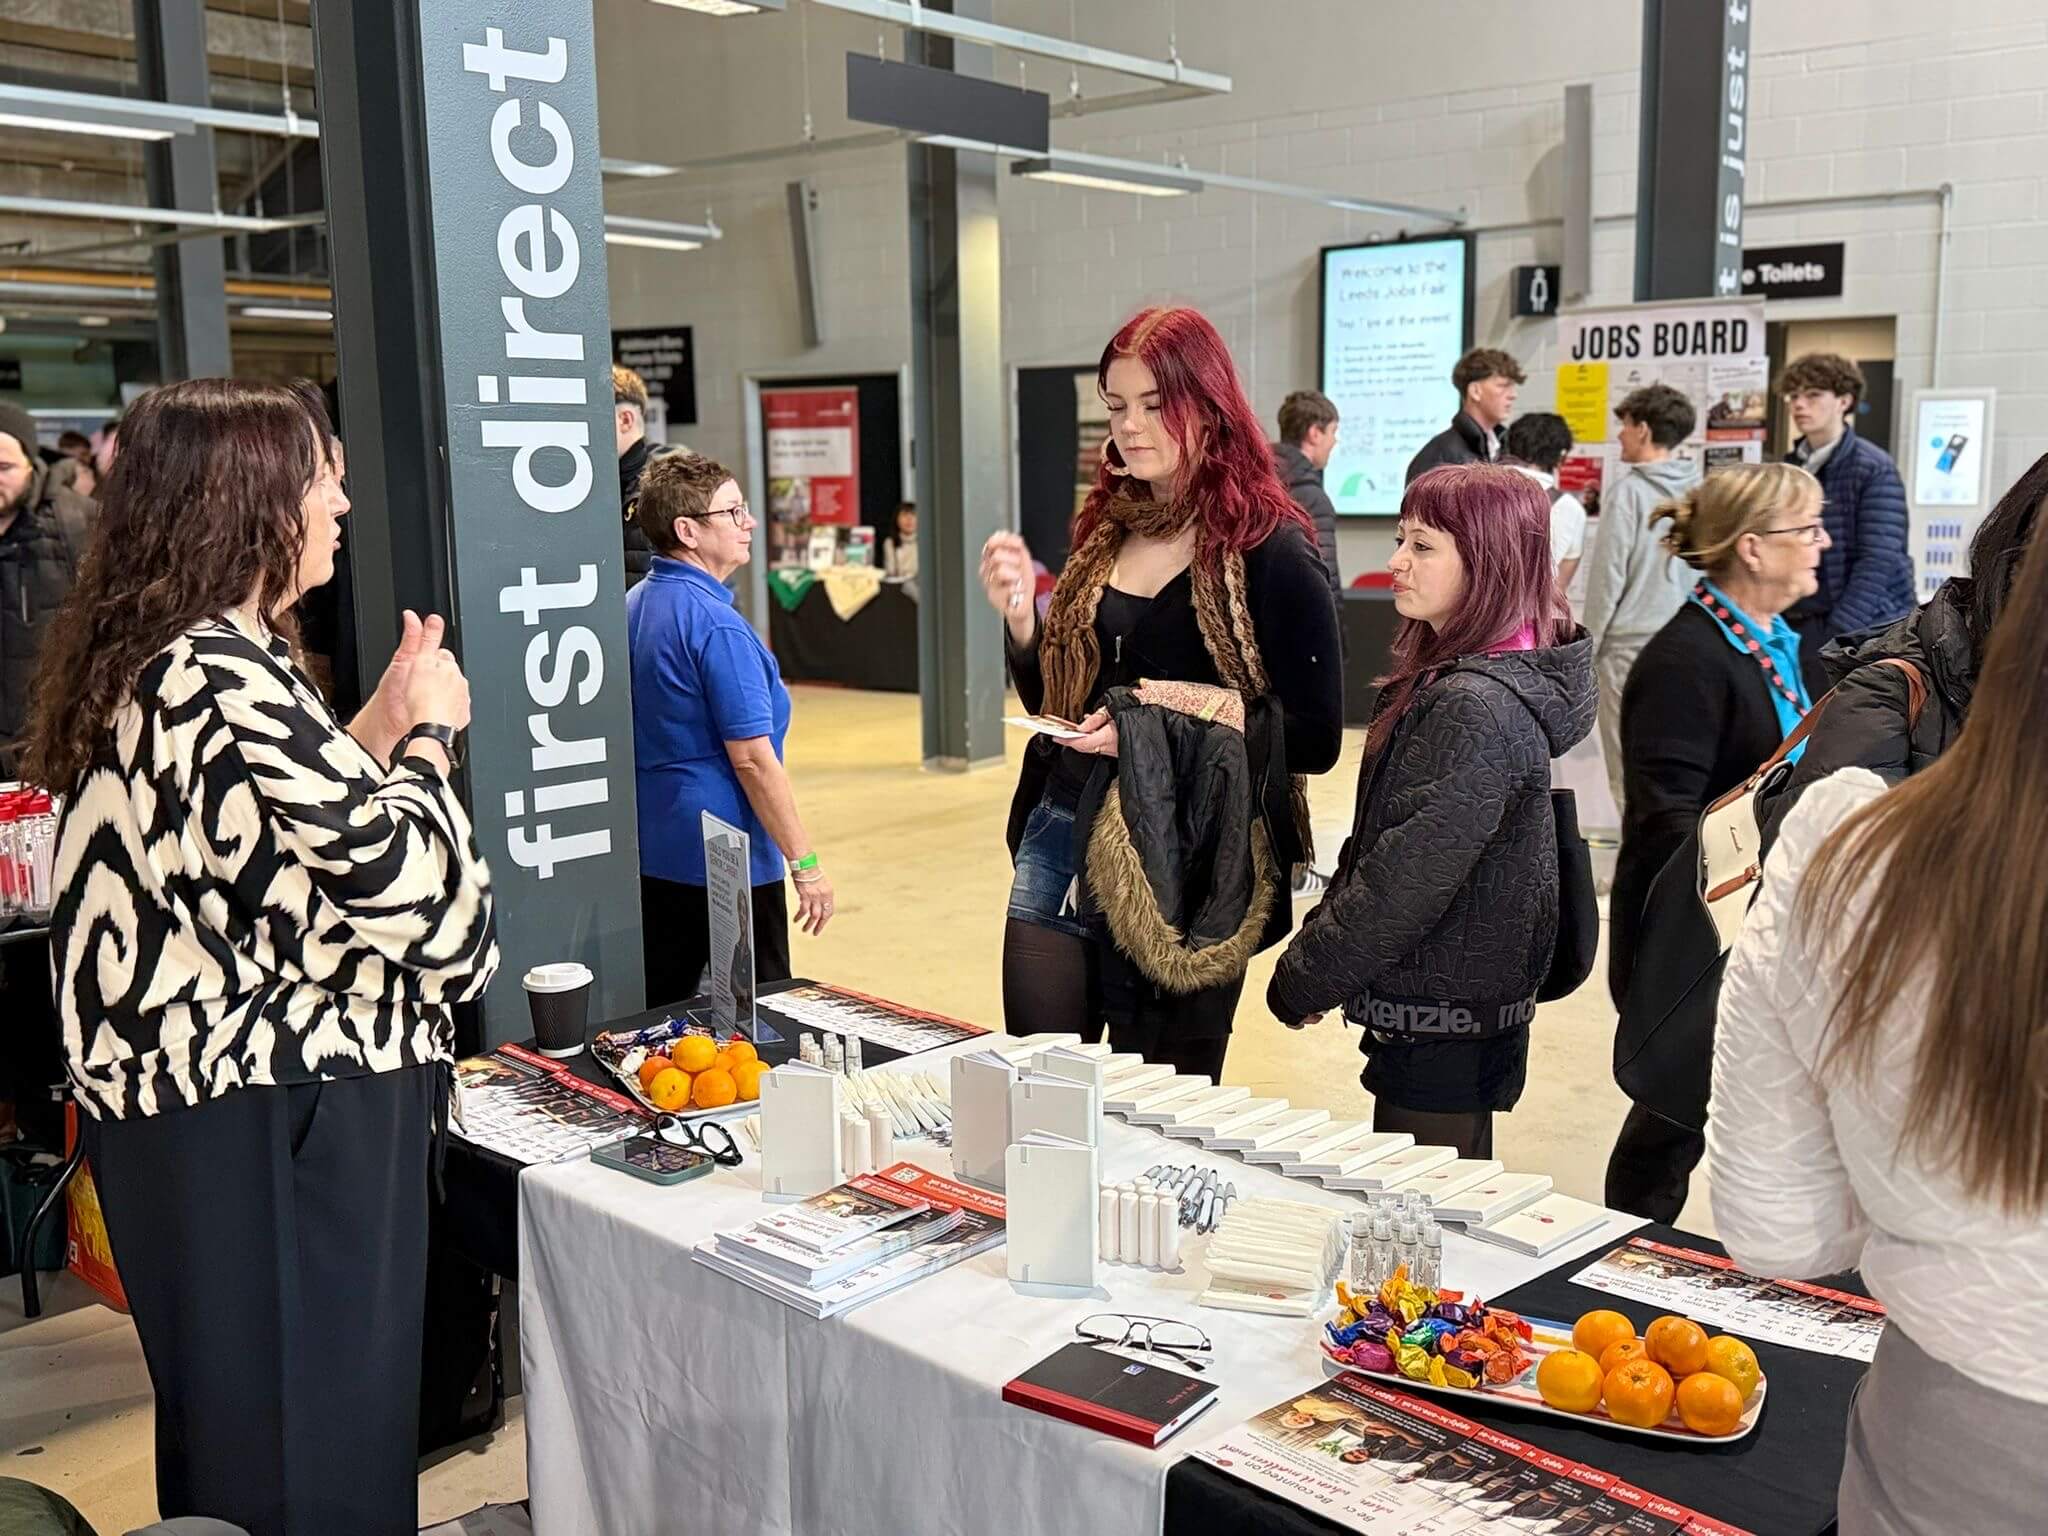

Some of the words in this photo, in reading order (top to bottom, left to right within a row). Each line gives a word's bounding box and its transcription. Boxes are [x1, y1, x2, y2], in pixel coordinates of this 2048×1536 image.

[1722, 47, 1746, 177] just
[1720, 193, 1740, 246] is
[462, 27, 594, 515] direct
[1758, 263, 1825, 284] Toilets
[1572, 324, 1641, 361] JOBS
[1653, 319, 1748, 357] BOARD
[500, 562, 613, 881] first
[1220, 1443, 1250, 1457] most
[1245, 1460, 1262, 1471] on
[1252, 1454, 1301, 1477] matters
[1260, 1467, 1313, 1495] counted
[1301, 1474, 1316, 1484] it
[1317, 1480, 1351, 1497] when
[1316, 1493, 1334, 1505] Be
[1357, 1511, 1376, 1523] Be
